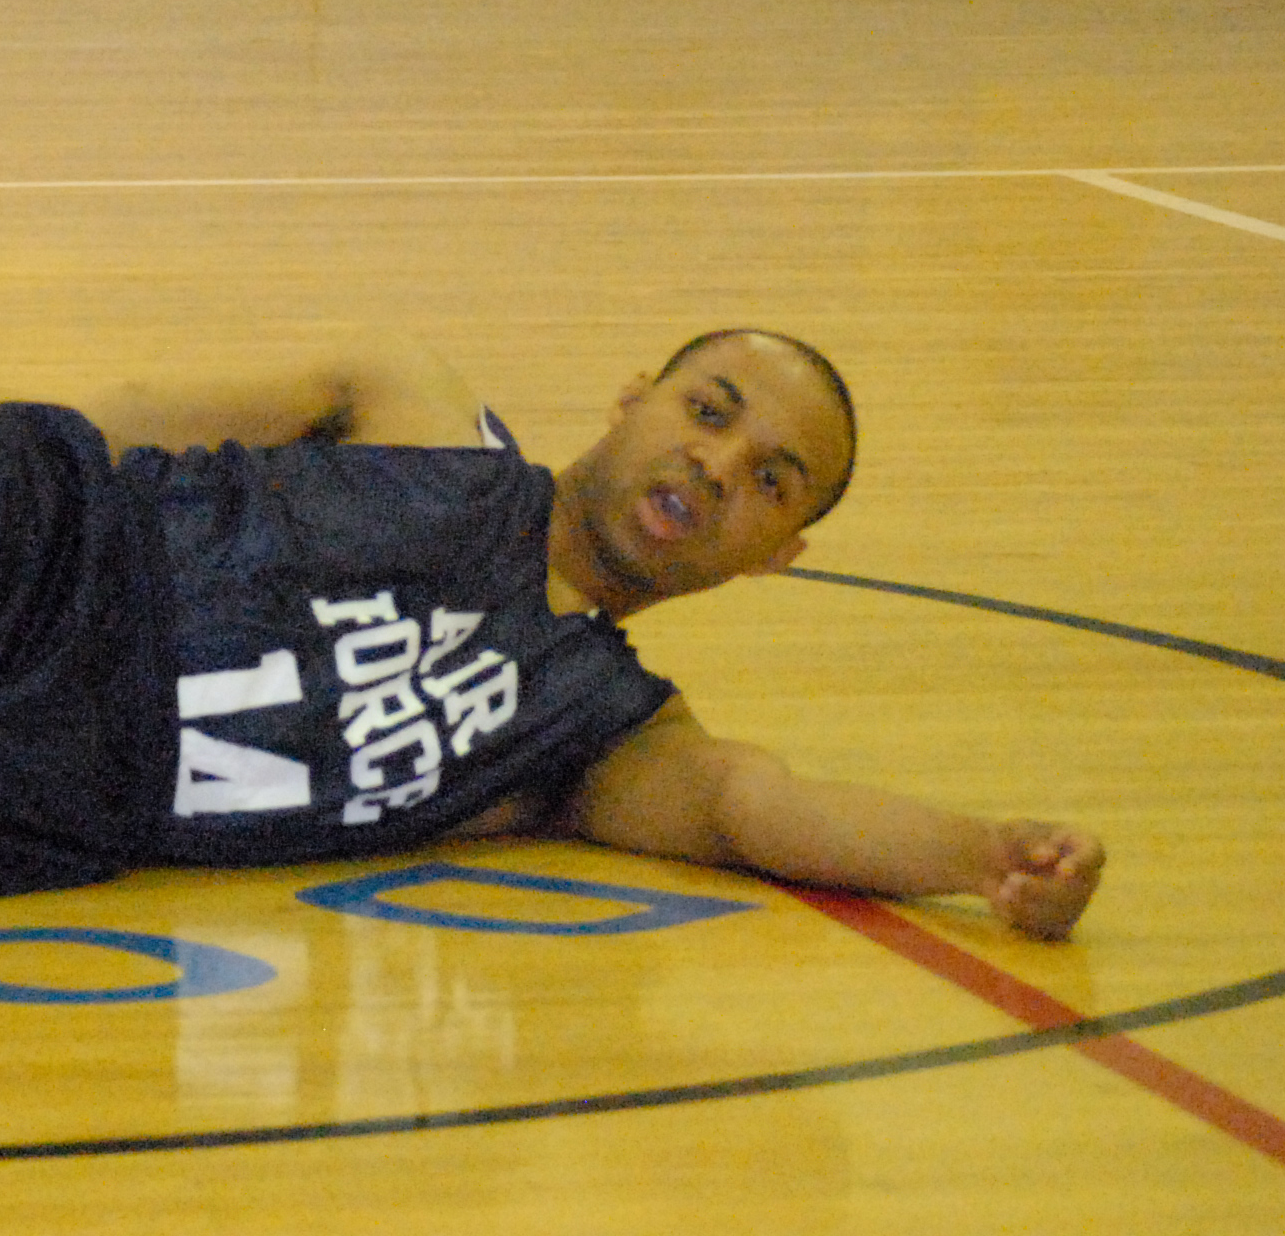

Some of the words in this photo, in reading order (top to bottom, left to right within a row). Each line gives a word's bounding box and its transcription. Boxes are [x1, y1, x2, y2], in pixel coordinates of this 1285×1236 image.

[173, 649, 312, 818] 14
[310, 590, 443, 826] FORCE
[418, 607, 519, 757] AIR
